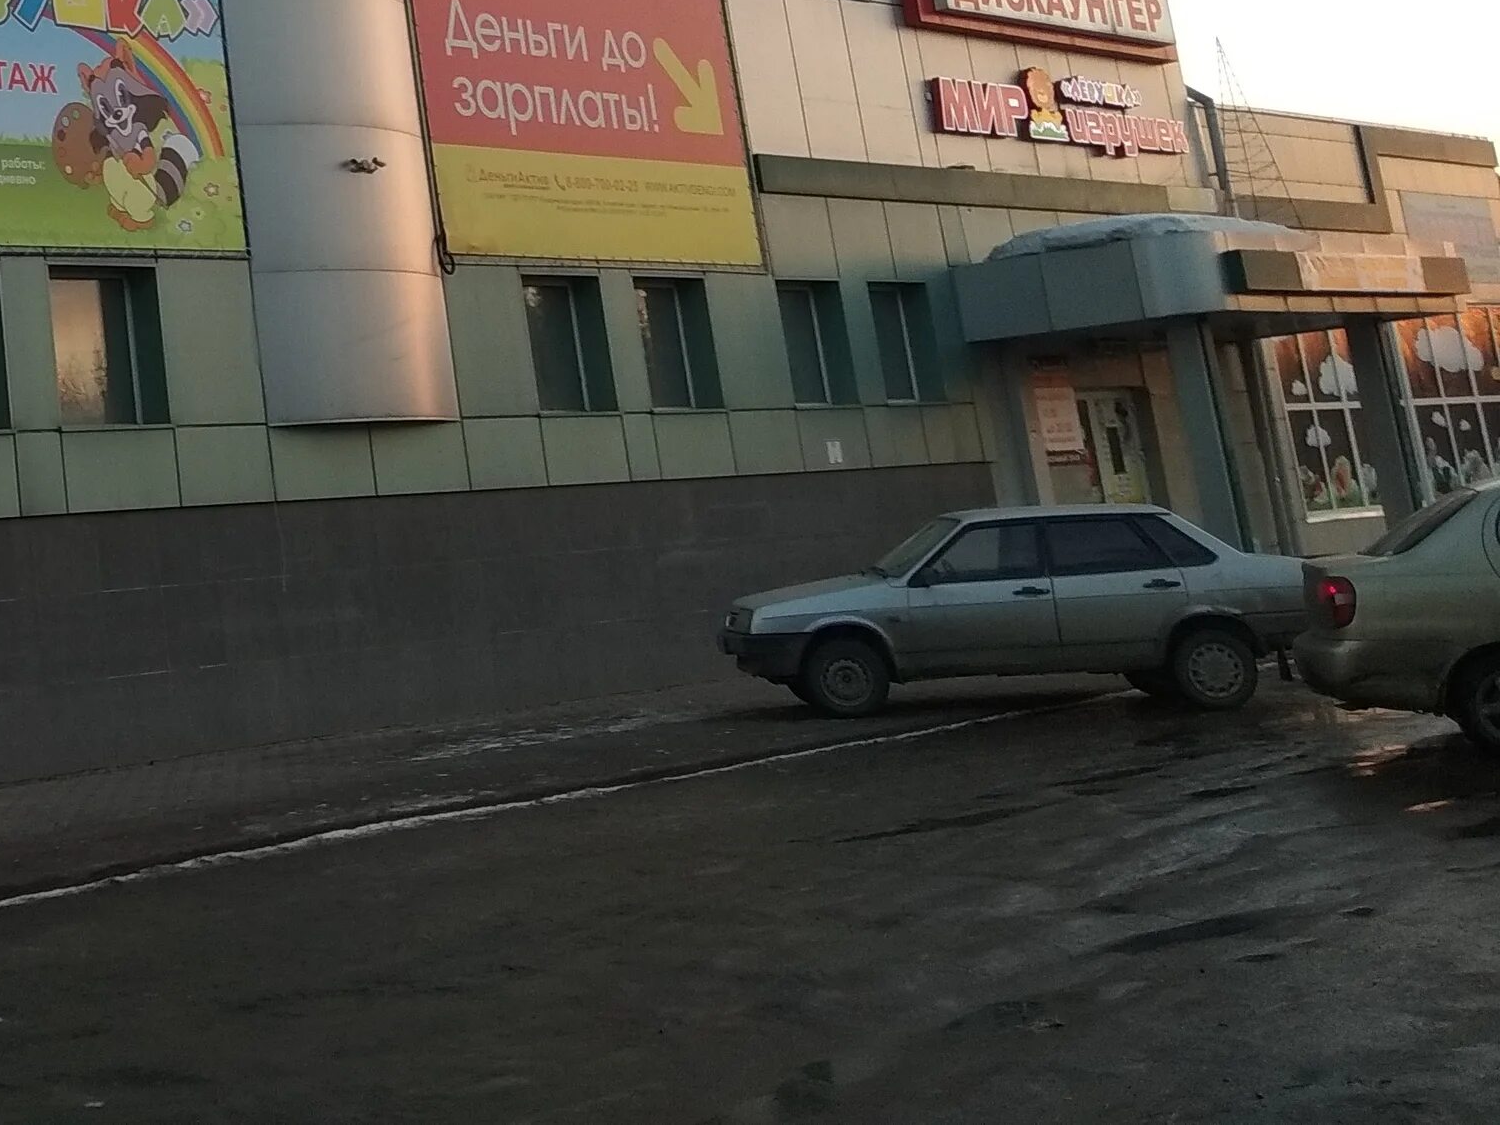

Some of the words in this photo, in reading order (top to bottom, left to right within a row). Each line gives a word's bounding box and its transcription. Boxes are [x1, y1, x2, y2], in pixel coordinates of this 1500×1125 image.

[602, 29, 647, 72] до
[452, 76, 659, 135] зарплаты!
[940, 77, 1028, 137] МИР
